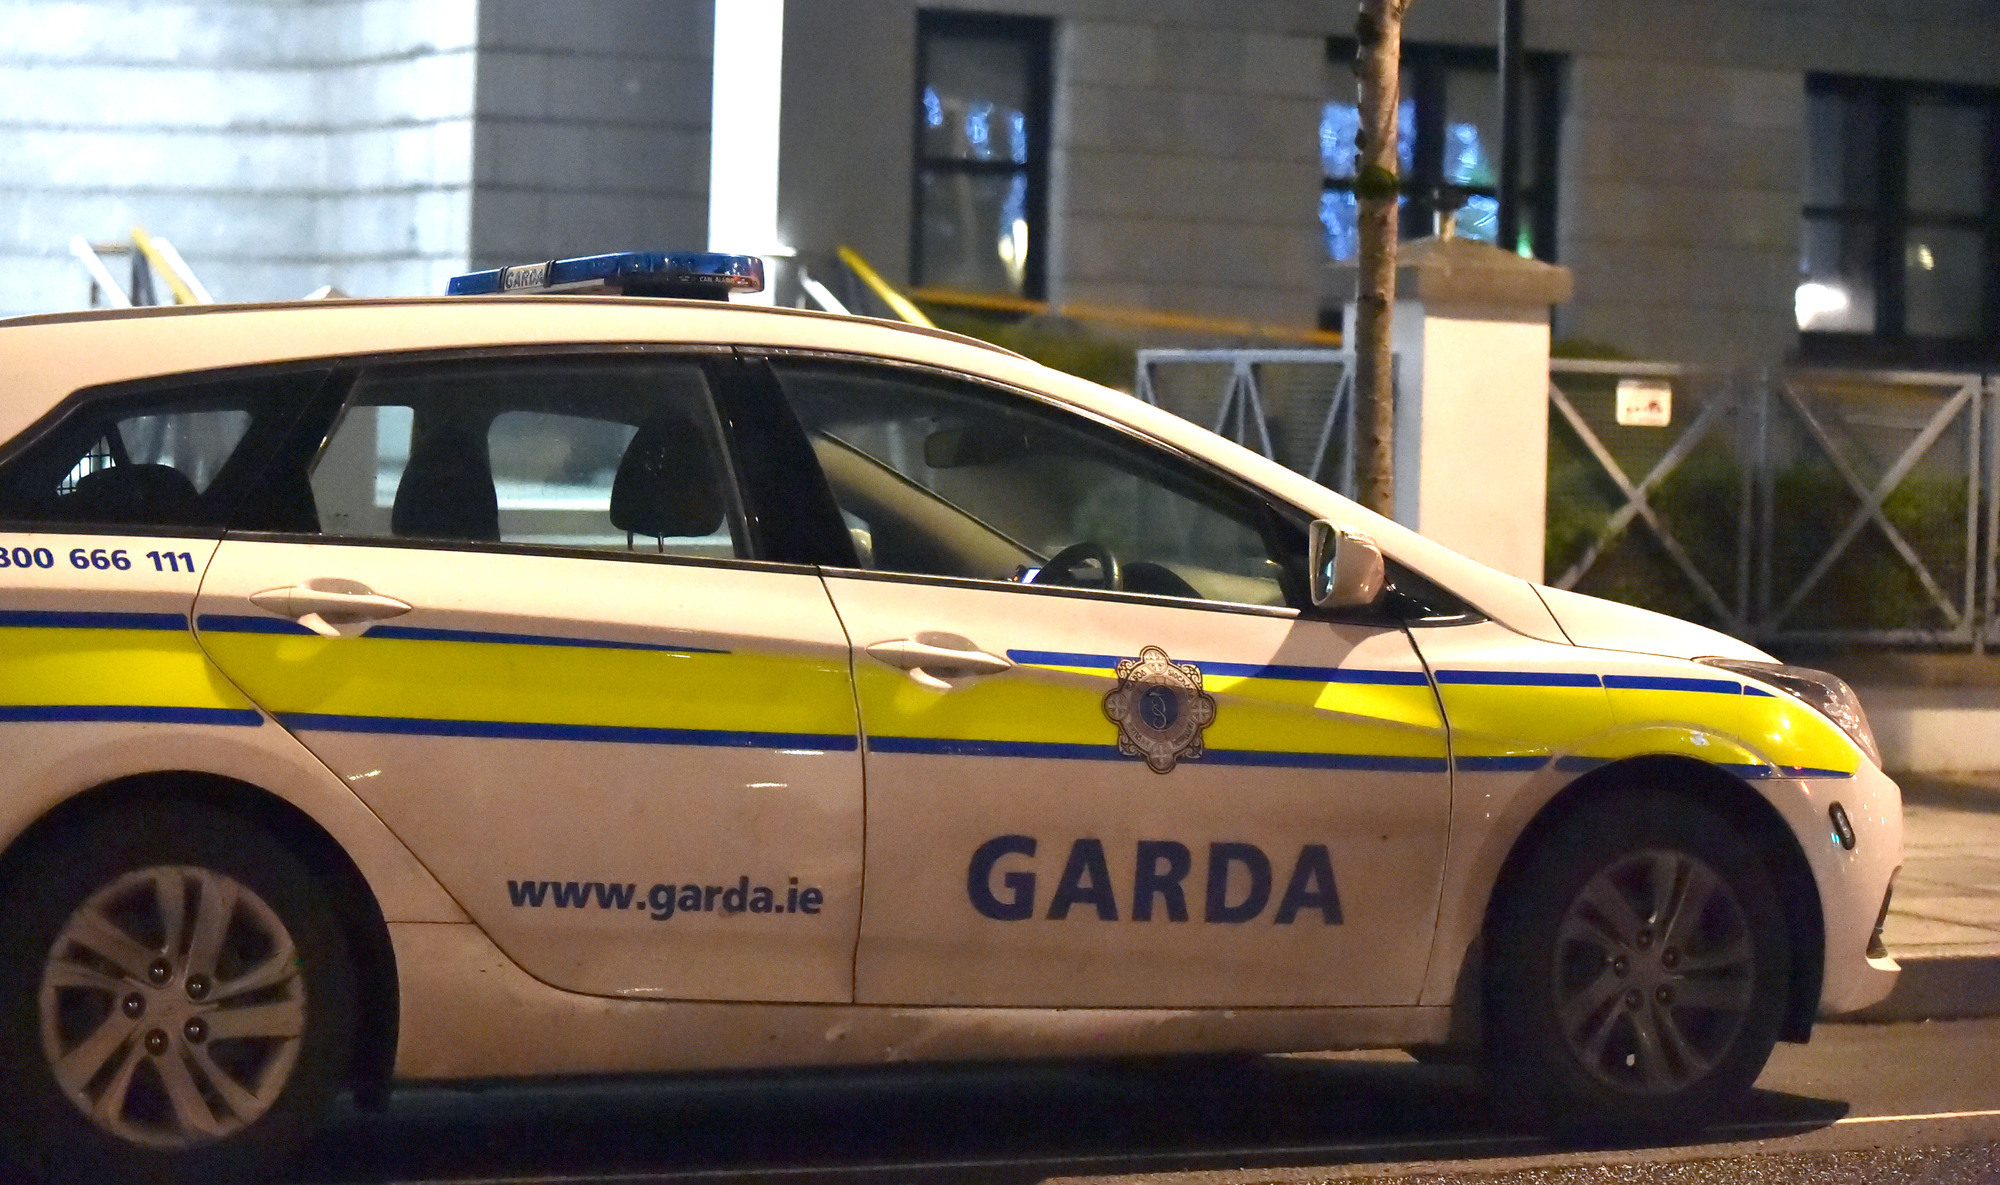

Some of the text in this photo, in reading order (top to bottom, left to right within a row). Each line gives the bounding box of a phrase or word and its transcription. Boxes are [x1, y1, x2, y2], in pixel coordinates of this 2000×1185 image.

[505, 268, 544, 288] GARDA
[69, 548, 131, 570] 666
[146, 551, 195, 572] 111
[966, 834, 1344, 925] GARDA
[507, 876, 824, 921] www.garda.ie
